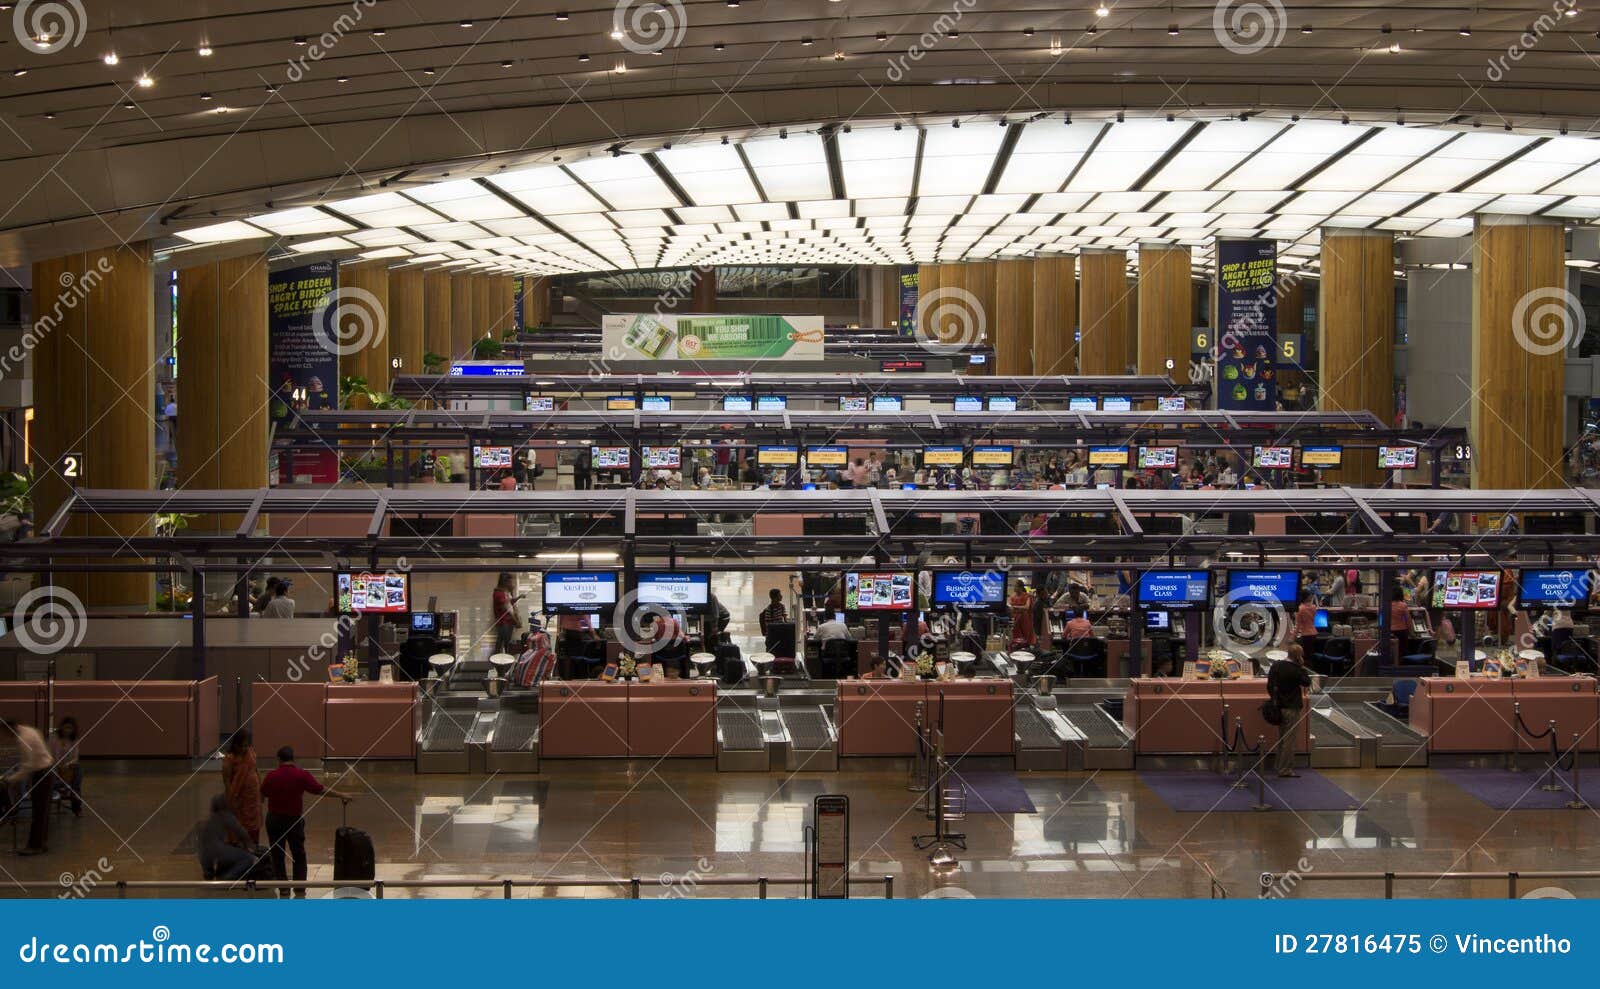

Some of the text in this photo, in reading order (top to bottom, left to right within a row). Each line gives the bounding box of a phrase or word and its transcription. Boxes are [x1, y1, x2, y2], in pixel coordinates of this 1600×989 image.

[1222, 263, 1240, 273] SHOP
[1248, 259, 1274, 270] REDEEM
[1223, 271, 1248, 280] ANGRY
[298, 277, 332, 290] REDEEM
[1227, 279, 1250, 289] SPACE
[270, 291, 297, 302] ANGRY
[274, 297, 330, 313] SPACE PLUSH
[1197, 333, 1207, 348] 6
[1283, 341, 1295, 357] 5
[392, 358, 399, 368] 6
[1455, 445, 1463, 459] 3
[64, 456, 77, 477] 2
